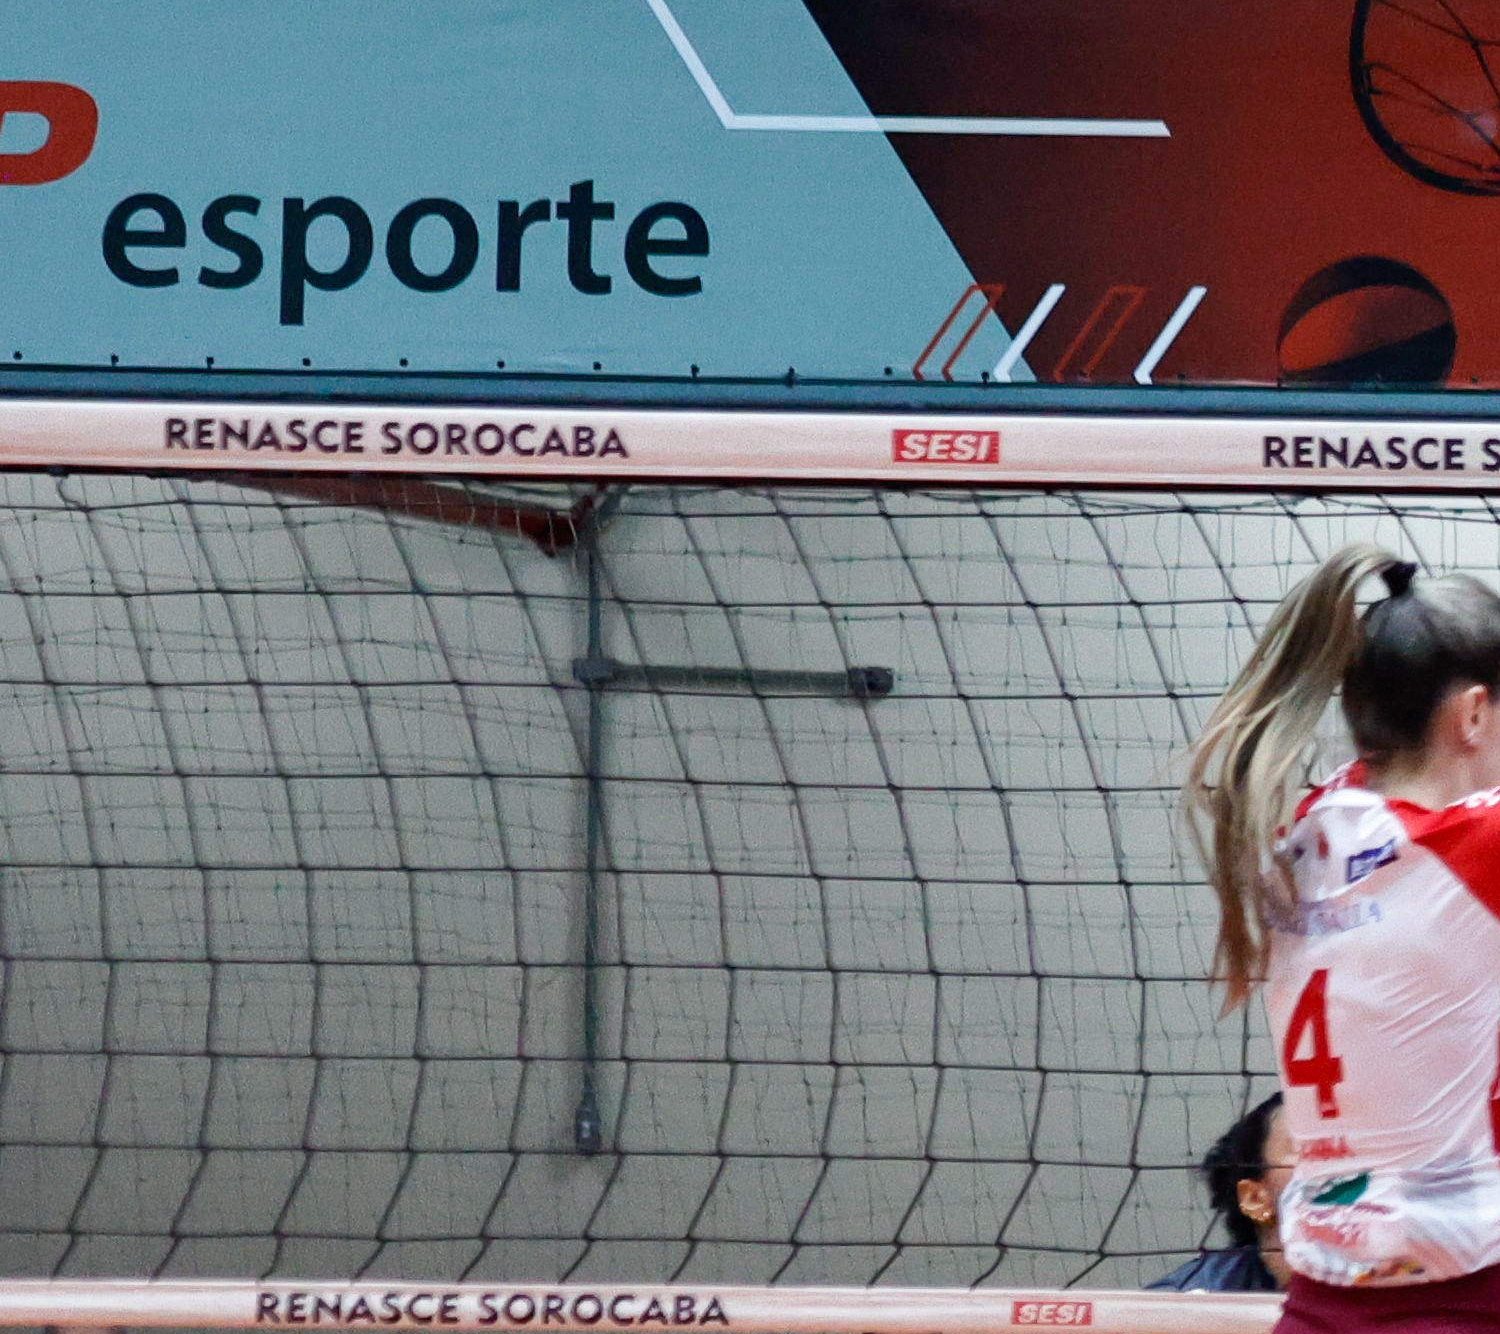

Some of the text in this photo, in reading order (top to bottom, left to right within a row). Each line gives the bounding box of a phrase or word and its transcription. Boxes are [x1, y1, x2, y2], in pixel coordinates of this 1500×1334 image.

[0, 80, 99, 186] P
[102, 180, 711, 327] esporte
[165, 417, 629, 459] RENASCE SOROCABA
[900, 434, 991, 461] SESI
[1262, 435, 1466, 471] RENASCE
[1283, 969, 1343, 1118] 4
[256, 1292, 730, 1327] RENASCE SOROCABA
[1016, 1303, 1088, 1324] SESI
